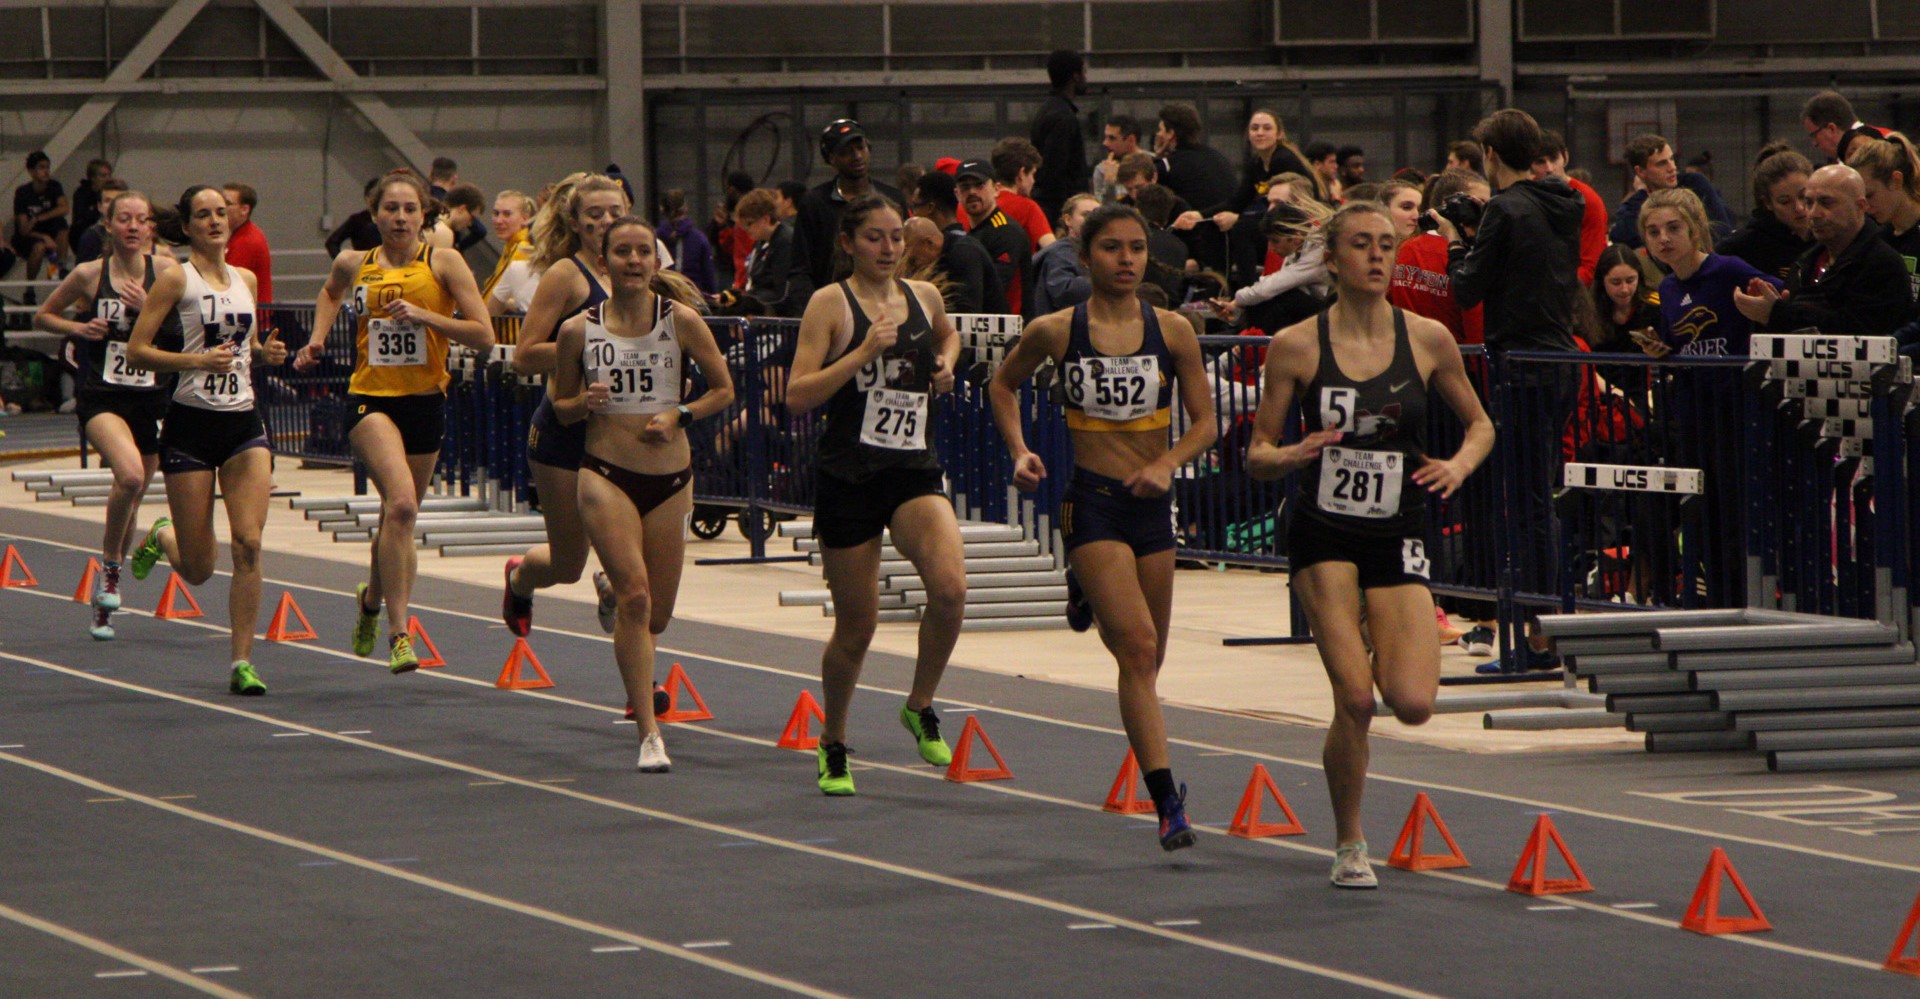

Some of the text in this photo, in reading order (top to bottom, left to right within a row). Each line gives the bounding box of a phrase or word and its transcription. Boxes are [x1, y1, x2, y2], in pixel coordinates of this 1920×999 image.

[102, 300, 120, 320] 12
[203, 294, 216, 322] 7
[354, 286, 364, 315] 6
[970, 317, 990, 332] UCS
[378, 332, 416, 356] 336
[986, 333, 1005, 347] UCS
[1803, 339, 1838, 360] UCS
[591, 342, 615, 367] 10
[623, 352, 639, 360] TEAM
[1111, 358, 1129, 366] TEAM
[609, 368, 653, 394] 315
[861, 360, 878, 388] 9
[1104, 366, 1139, 375] HALLENGE
[1817, 361, 1853, 379] UCS
[204, 372, 239, 396] 478
[1069, 365, 1085, 402] 8
[1095, 375, 1145, 407] 552
[874, 406, 917, 438] 275
[1328, 390, 1348, 430] 5
[1343, 458, 1382, 471] CHALLENGE
[1354, 451, 1374, 461] TEAM
[1333, 468, 1385, 504] 281
[1613, 469, 1648, 489] UCS
